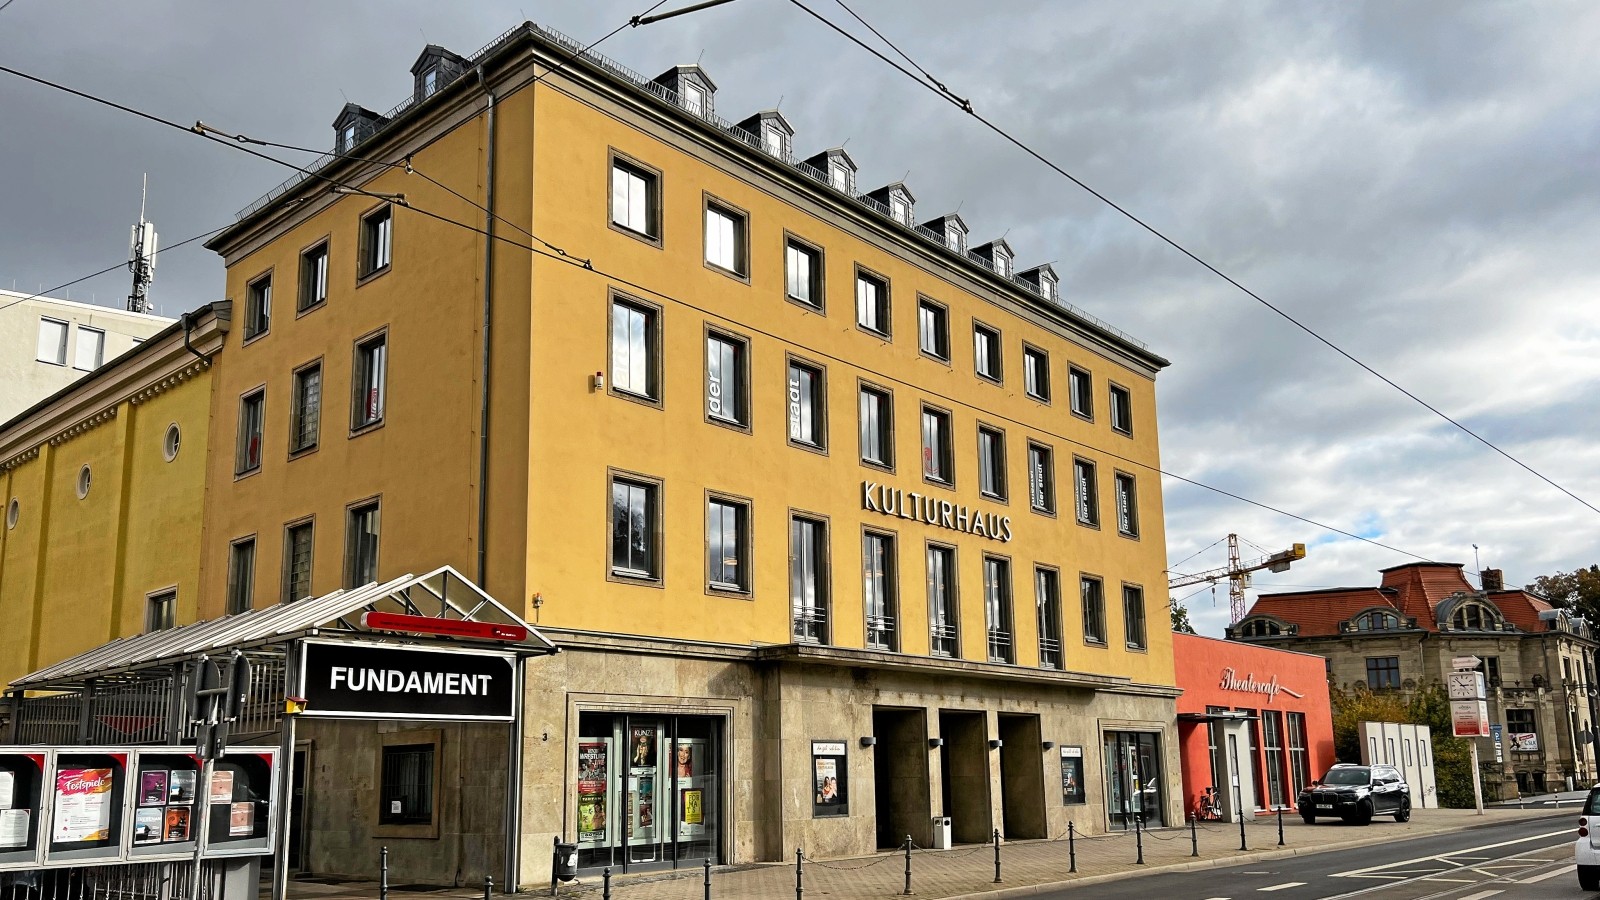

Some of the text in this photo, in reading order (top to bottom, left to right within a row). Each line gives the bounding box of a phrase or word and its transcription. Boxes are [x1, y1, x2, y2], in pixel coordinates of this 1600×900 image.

[708, 371, 720, 413] der
[790, 379, 800, 437] stadt
[863, 480, 1012, 542] KULTURHAUS
[330, 666, 493, 696] FUNDAMENT
[542, 732, 548, 741] 3
[635, 729, 654, 737] KUNZE
